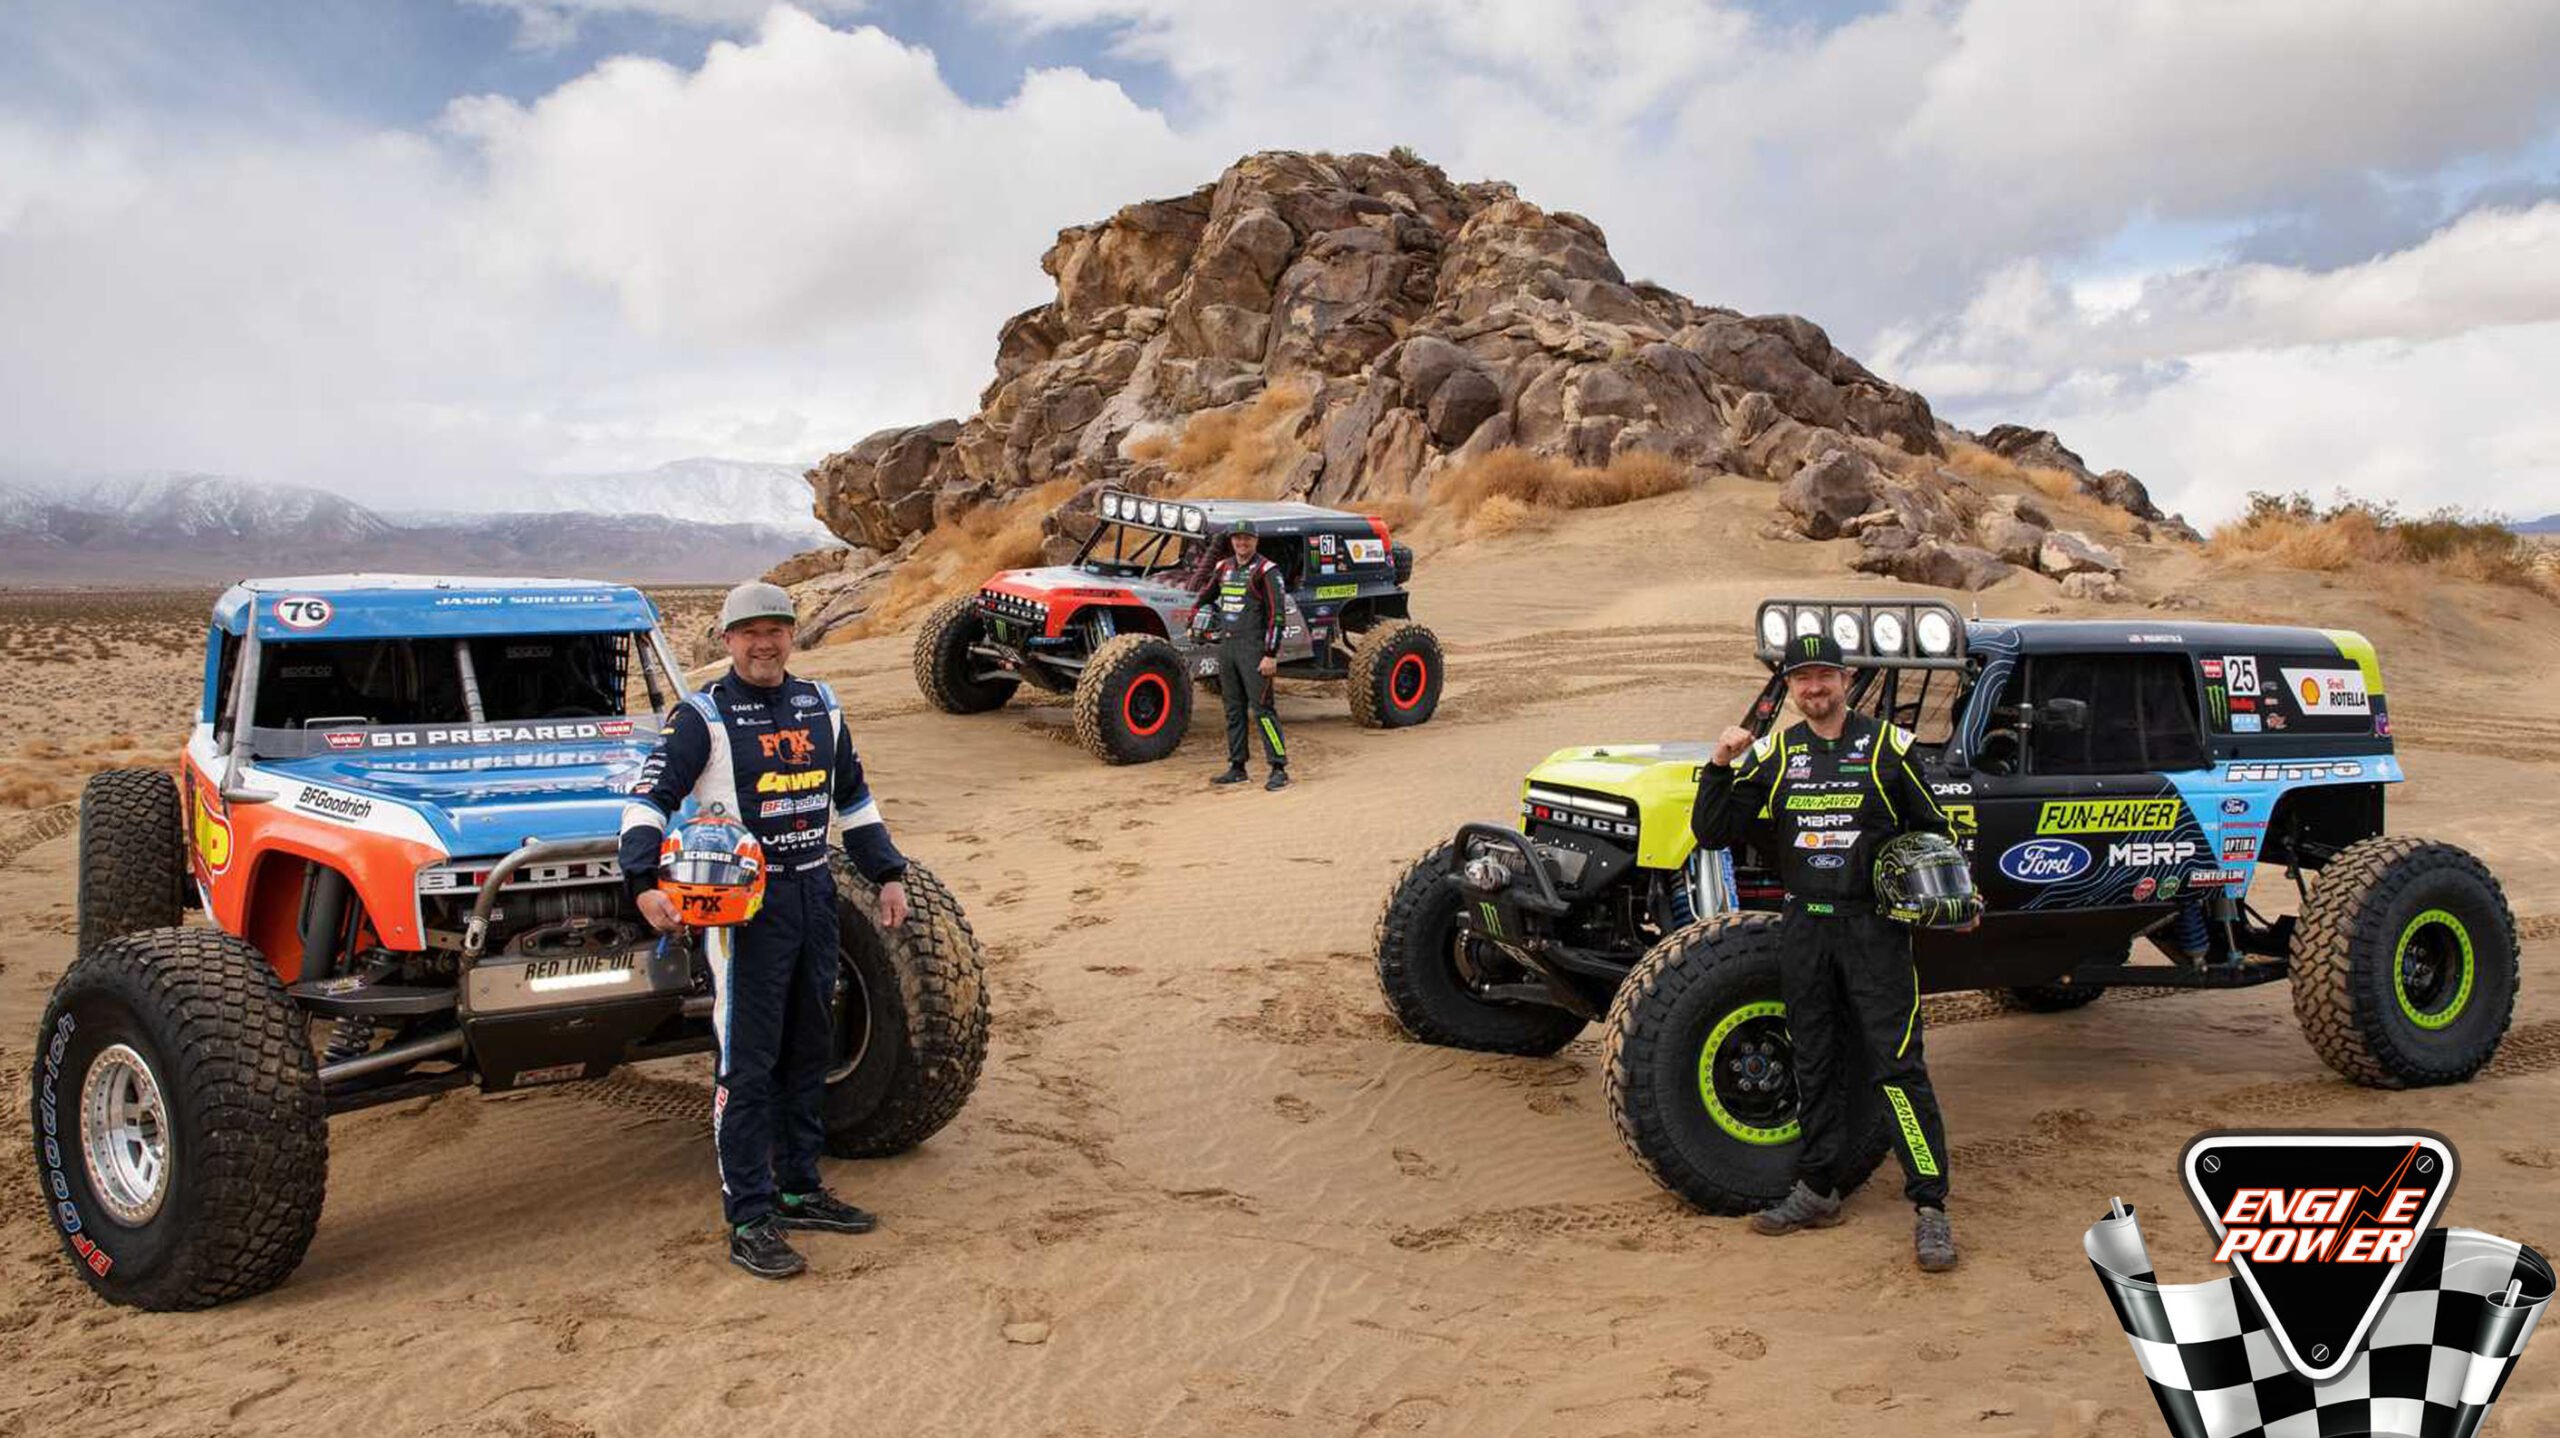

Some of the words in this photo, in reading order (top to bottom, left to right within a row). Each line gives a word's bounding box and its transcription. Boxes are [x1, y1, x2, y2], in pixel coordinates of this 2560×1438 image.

[1321, 536, 1333, 554] 67
[284, 602, 326, 621] 76
[436, 596, 502, 605] JASON
[2229, 659, 2256, 692] 25
[2330, 692, 2366, 706] ROTELLA
[371, 731, 417, 746] GO
[427, 723, 597, 744] PREPARED
[758, 729, 815, 760] FOX
[2225, 760, 2363, 782] NITTO
[1931, 783, 1972, 794] CARO
[299, 786, 372, 818] BFGoodrich
[1524, 803, 1638, 835] BRONCO
[1797, 814, 1853, 827] MBRP
[1941, 805, 1978, 828] TR
[2042, 803, 2175, 829] FUN-HAVER
[683, 851, 732, 862] SCHERER
[2108, 842, 2196, 867] MBRP
[2224, 838, 2256, 852] OPTIMA
[2018, 845, 2074, 875] Ford
[682, 895, 722, 912] FOX
[524, 961, 559, 980] RED
[566, 956, 603, 975] LINE
[610, 953, 635, 970] OIL
[1887, 1087, 1936, 1173] FUN-HAVER
[40, 1012, 114, 1278] BFGoodrich
